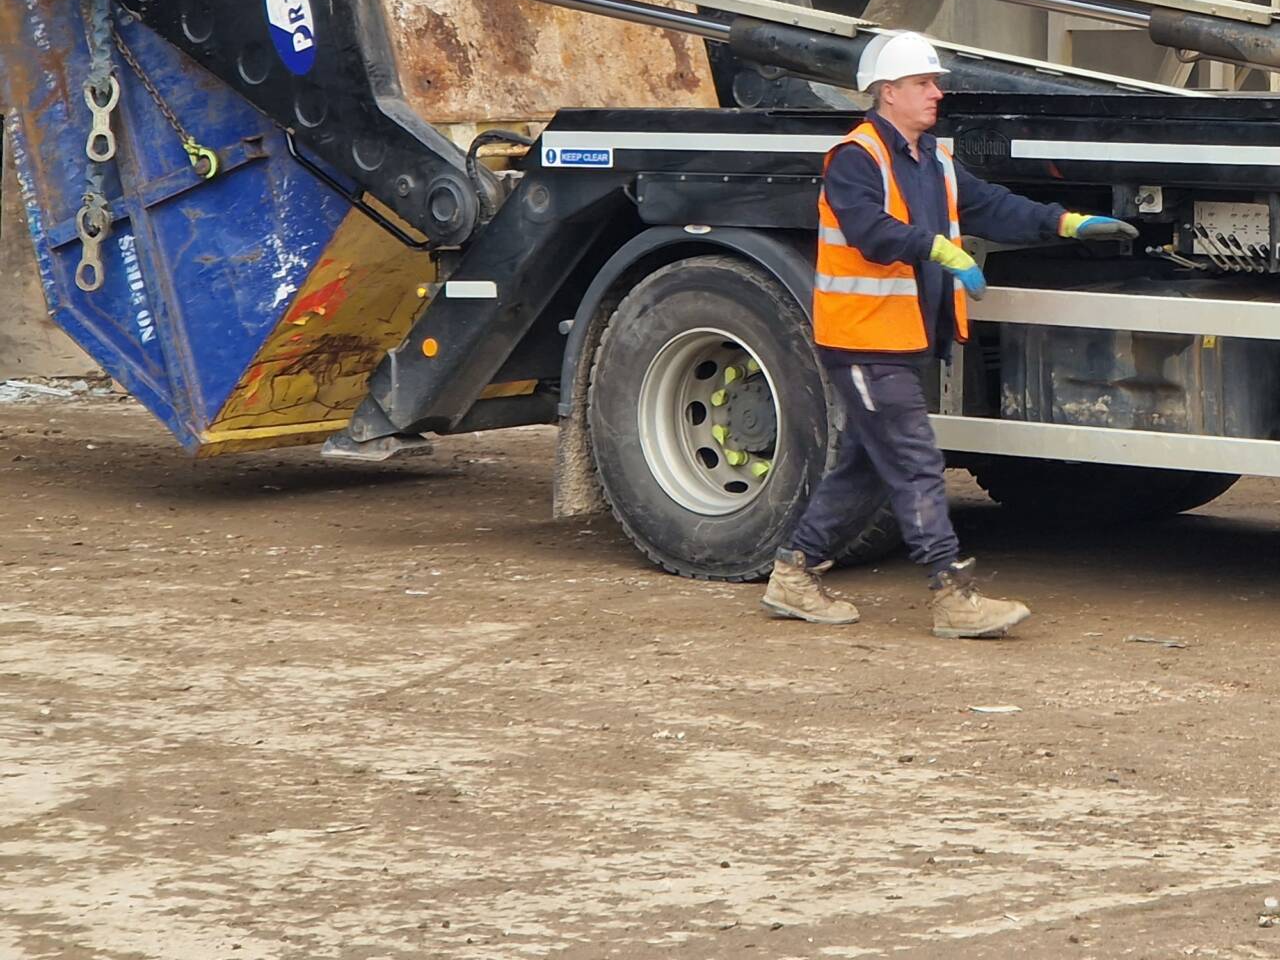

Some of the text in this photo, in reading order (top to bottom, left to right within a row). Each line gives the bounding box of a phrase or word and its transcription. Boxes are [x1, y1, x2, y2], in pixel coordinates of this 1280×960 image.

[561, 153, 609, 162] KEEP CLEAR
[136, 309, 158, 344] NO
